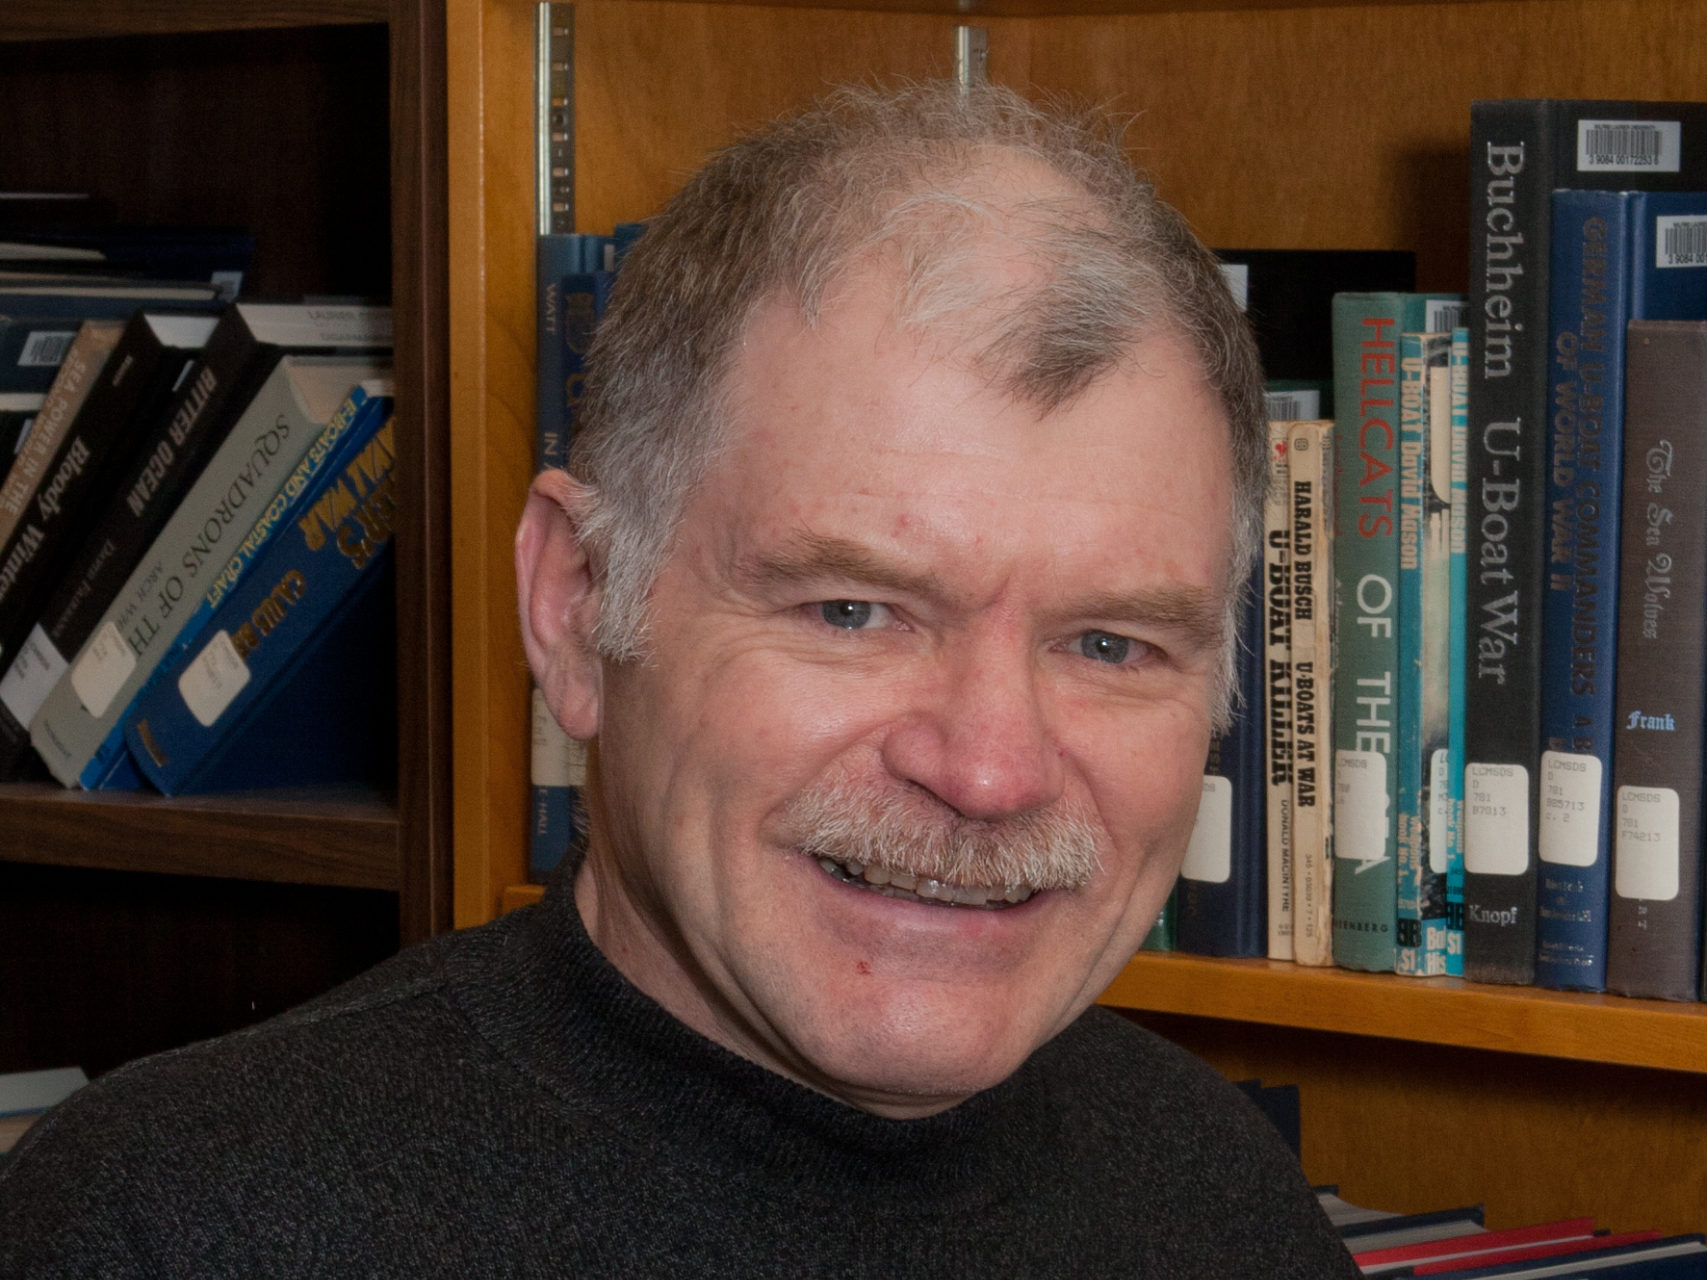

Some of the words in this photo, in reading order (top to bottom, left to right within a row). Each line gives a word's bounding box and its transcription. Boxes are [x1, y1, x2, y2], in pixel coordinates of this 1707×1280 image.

[1483, 139, 1525, 380] Buchheim
[1580, 216, 1608, 353] GERMAN
[64, 362, 88, 394] SEA
[1555, 330, 1578, 371] OF
[37, 399, 69, 455] POWER
[168, 364, 218, 447] BITTER
[1357, 317, 1395, 539] HELLCATS
[1400, 356, 1422, 435] U-BOAT
[1577, 362, 1603, 472] U-BOAT
[306, 398, 358, 462] E-BOATS
[1553, 380, 1578, 489] WORLD
[3, 480, 29, 514] THE
[22, 457, 41, 480] IN
[36, 434, 92, 524] Bloody
[126, 440, 177, 518] OCEAN
[181, 413, 291, 579] SQUADRONS
[285, 456, 312, 498] AND
[1400, 441, 1422, 499] David
[1645, 438, 1674, 495] The
[242, 491, 288, 559] COASTAL
[1294, 480, 1312, 556] HARALD
[1479, 415, 1523, 587] U-Boat
[1550, 498, 1575, 565] WAR
[1646, 501, 1675, 546] Sea
[1400, 503, 1421, 571] Mason
[157, 573, 185, 621] OF
[208, 553, 244, 608] CRAFT
[1268, 529, 1292, 650] U-BOAT
[1294, 560, 1313, 620] BUSCH
[1356, 573, 1393, 639] OF
[1570, 480, 1601, 697] COMMANDERS
[128, 613, 161, 658] TH
[1477, 589, 1520, 686] War
[1270, 658, 1294, 787] KILLER
[1295, 661, 1316, 736] U-BOATS
[1355, 671, 1392, 755] THE
[1625, 709, 1677, 732] Frank
[1297, 739, 1316, 763] AT
[1471, 766, 1515, 778] LCMSDS
[1297, 767, 1317, 808] WAR
[1468, 904, 1519, 928] Knopf
